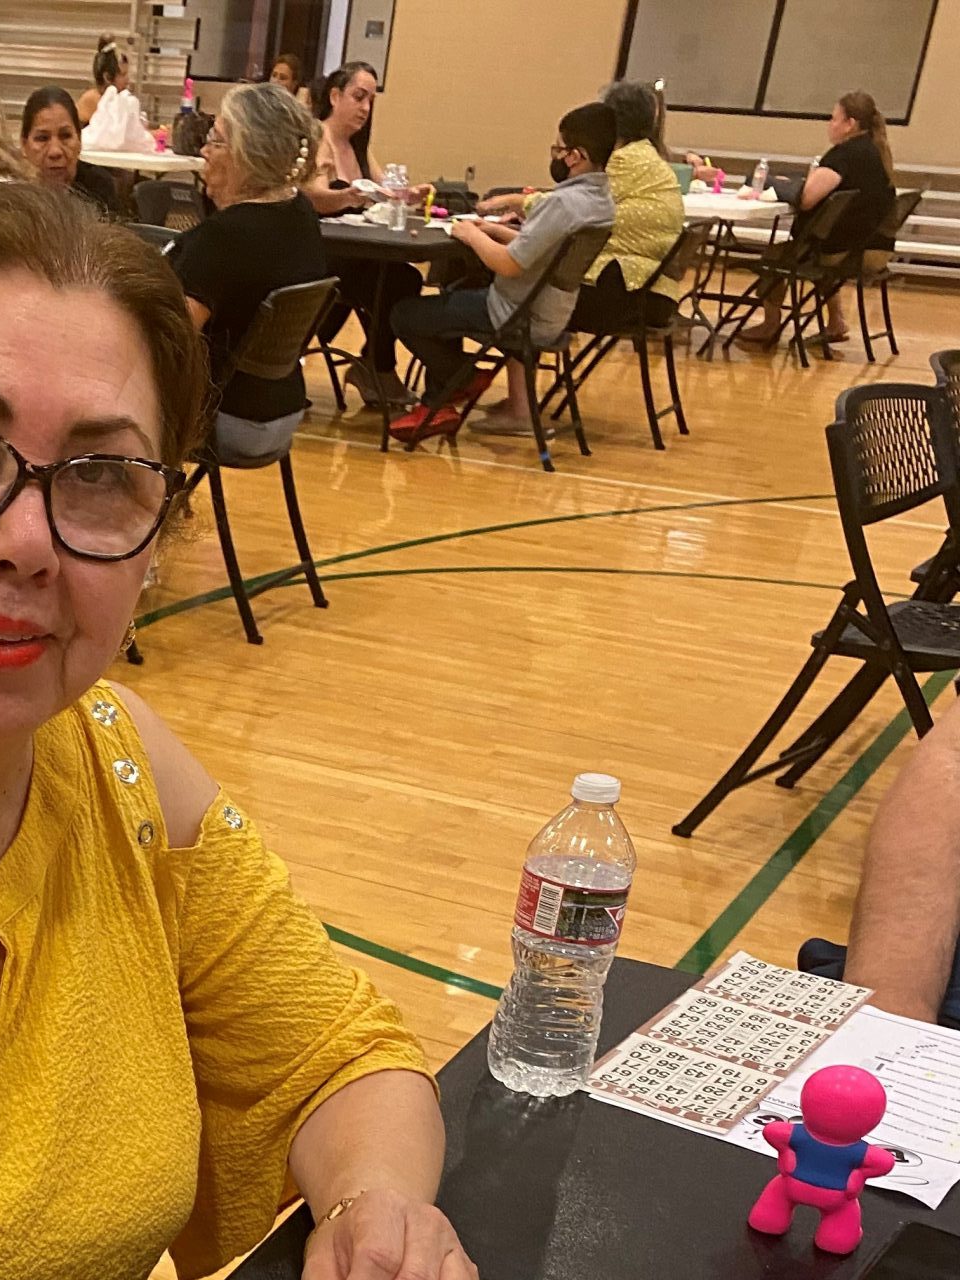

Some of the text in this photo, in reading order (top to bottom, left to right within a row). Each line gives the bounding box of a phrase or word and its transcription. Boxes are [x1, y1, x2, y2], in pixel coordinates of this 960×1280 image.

[612, 1067, 632, 1076] 61
[639, 1076, 661, 1086] 46
[666, 1085, 688, 1095] 44
[600, 1075, 734, 1120] 12 27 33 54 73
[694, 1095, 717, 1104] 24
